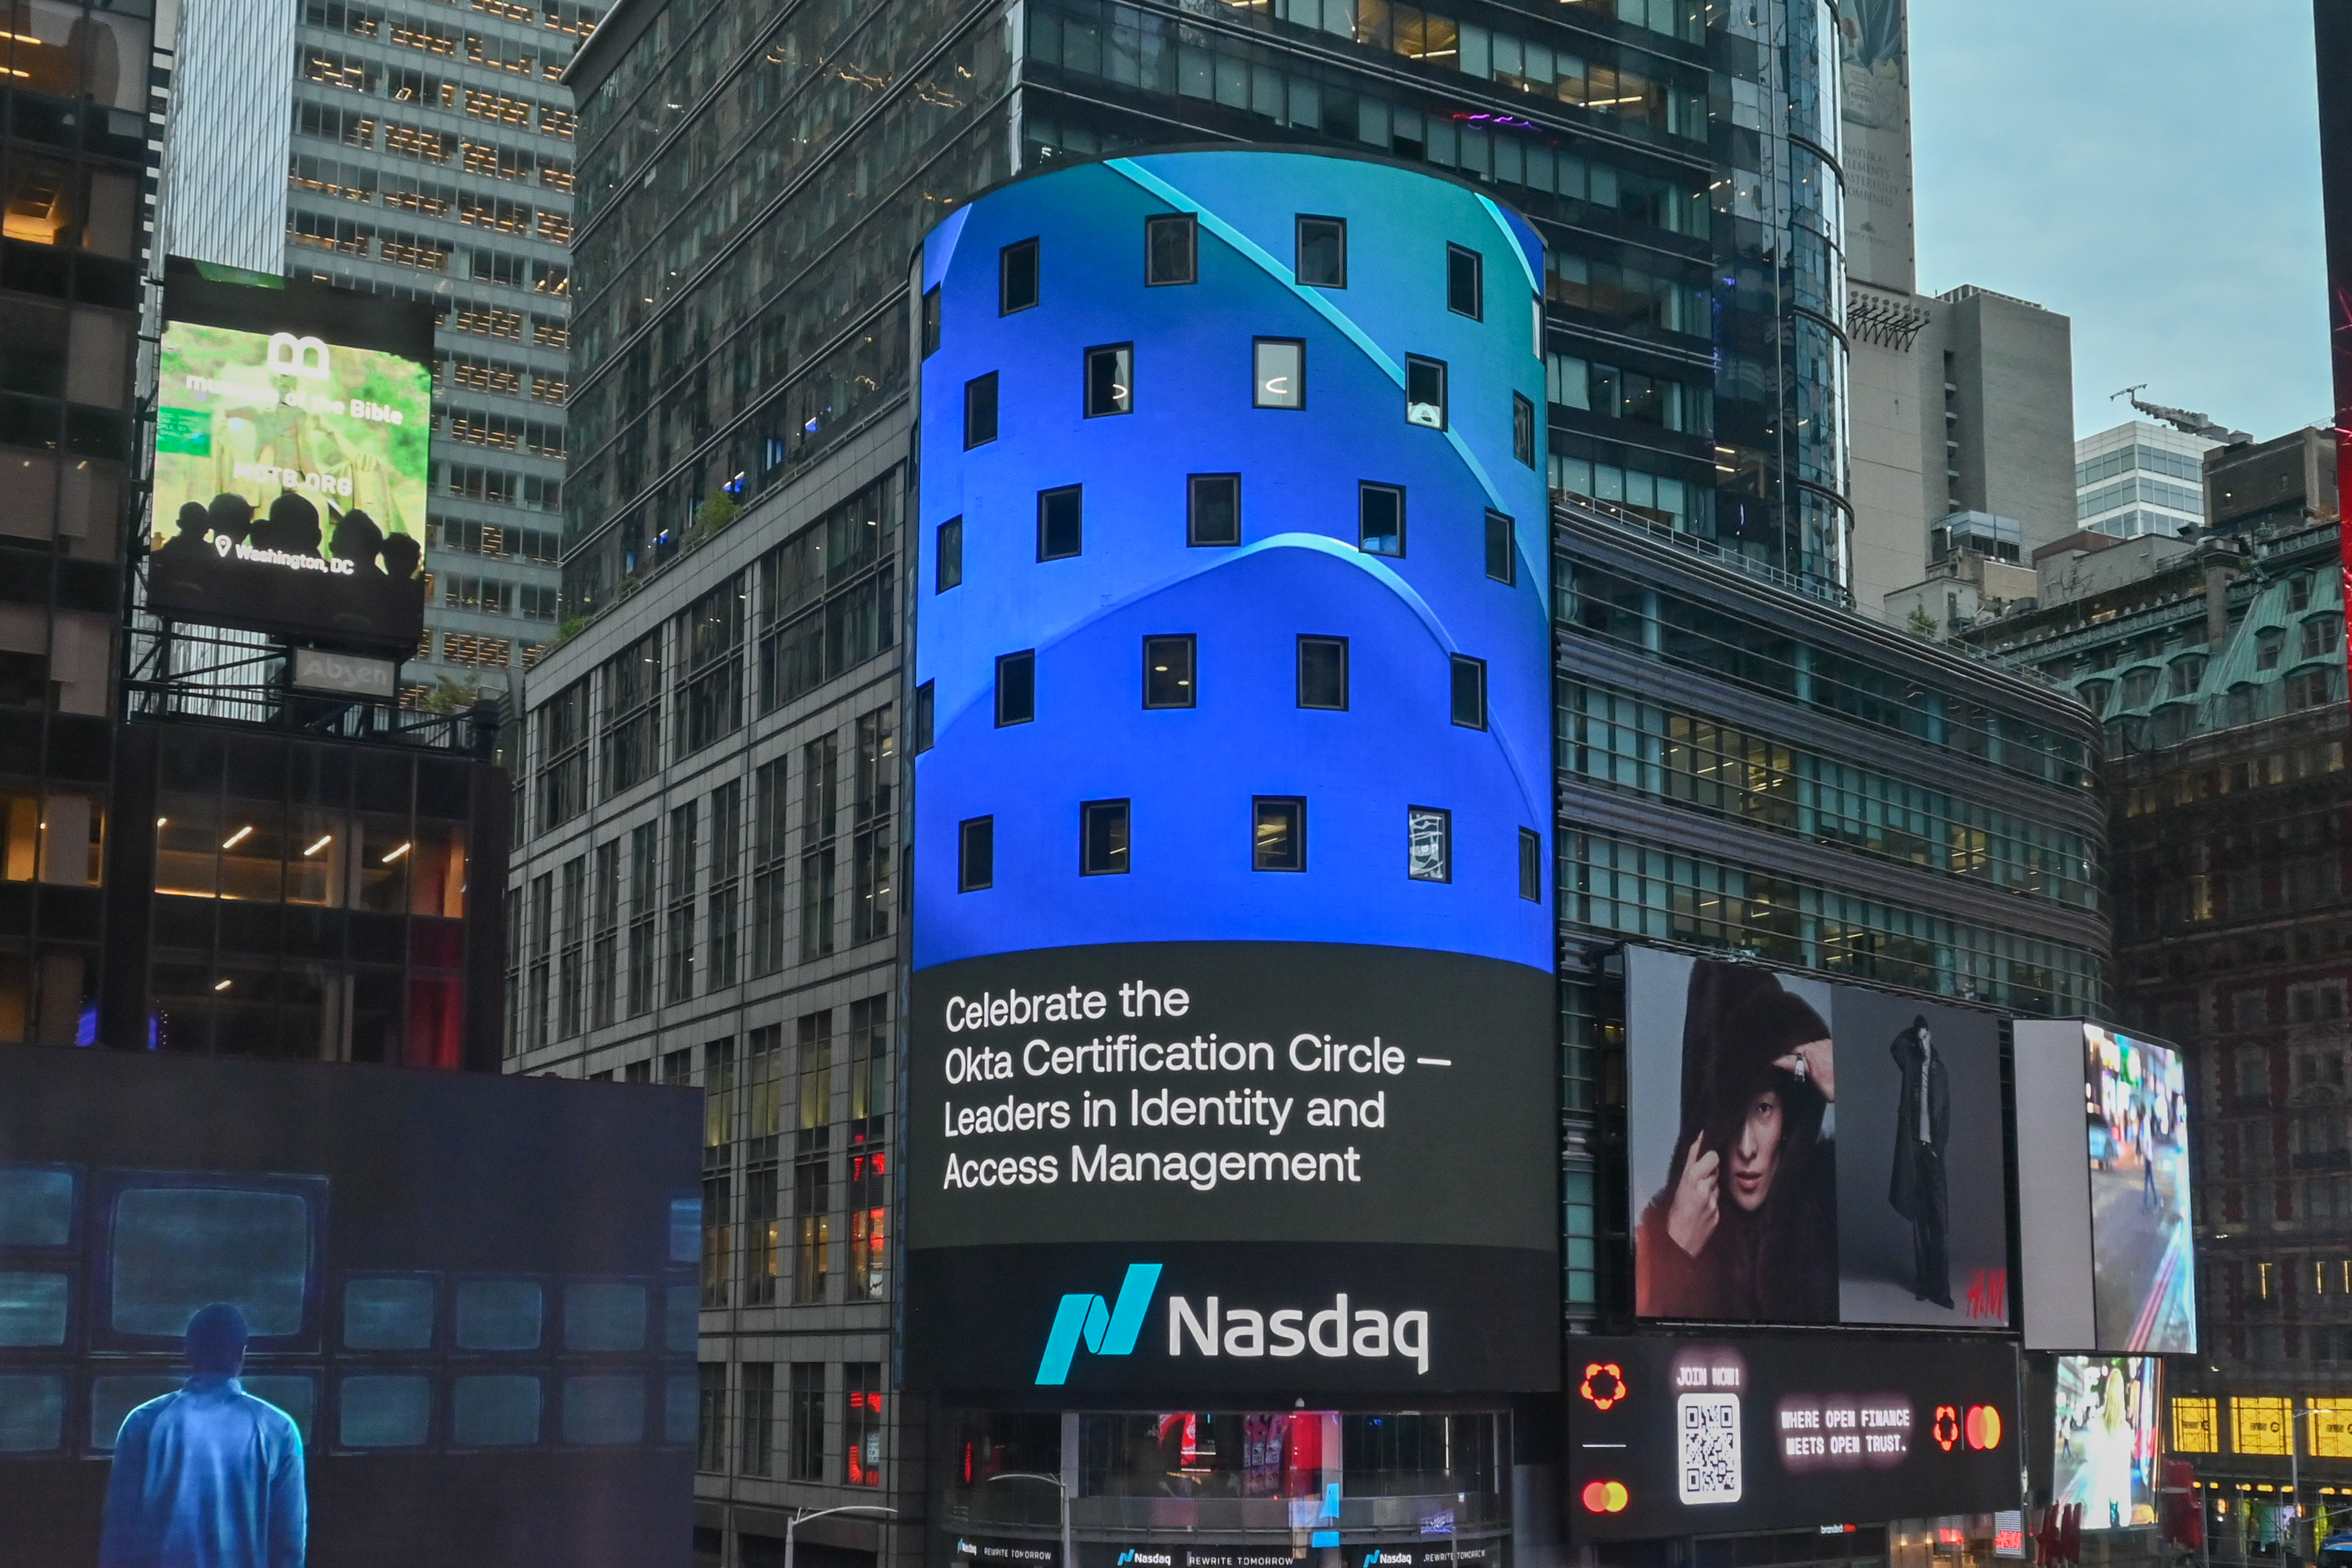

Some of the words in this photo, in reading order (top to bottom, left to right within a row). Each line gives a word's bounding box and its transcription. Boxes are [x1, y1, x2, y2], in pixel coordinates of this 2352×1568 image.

[1844, 145, 1889, 166] NATURAL
[1843, 157, 1890, 179] ELEMENTS
[1844, 173, 1899, 195] ASTERFULLY
[1846, 186, 1893, 207] OMBINED
[350, 399, 404, 425] Bible
[235, 544, 329, 573] Washington,
[330, 558, 355, 575] DC
[945, 985, 1107, 1032] Celebrate
[1119, 979, 1189, 1017] the
[945, 1047, 1014, 1084] Okta
[1023, 1034, 1274, 1076] Certification
[1289, 1034, 1405, 1075] Circle
[945, 1094, 1070, 1137] Leaders
[1083, 1090, 1117, 1128] in
[1131, 1088, 1294, 1136] Identity
[1306, 1090, 1385, 1128] and
[943, 1152, 1058, 1190] Access
[1072, 1144, 1361, 1191] Management
[1169, 1293, 1429, 1375] Nasdaq
[1677, 1367, 1707, 1386] JOIN
[1712, 1367, 1739, 1386] NOW!
[1781, 1410, 1819, 1428] WHERE
[1825, 1410, 1856, 1428] OPEN
[1861, 1409, 1910, 1427] FINANCE
[1786, 1436, 1825, 1455] MEETS
[1830, 1436, 1860, 1454] OPEN
[1866, 1434, 1907, 1452] TRUST.
[984, 1547, 1009, 1558] REWRITE
[1011, 1549, 1052, 1561] TOMORROW
[1134, 1552, 1171, 1565] Nasdaq
[1189, 1557, 1232, 1565] REWRITE
[1237, 1557, 1294, 1565] TOMORROW
[1379, 1552, 1412, 1565] Nasdaq
[1425, 1552, 1454, 1563] REWRITE
[1457, 1549, 1486, 1560] TOMORROW
